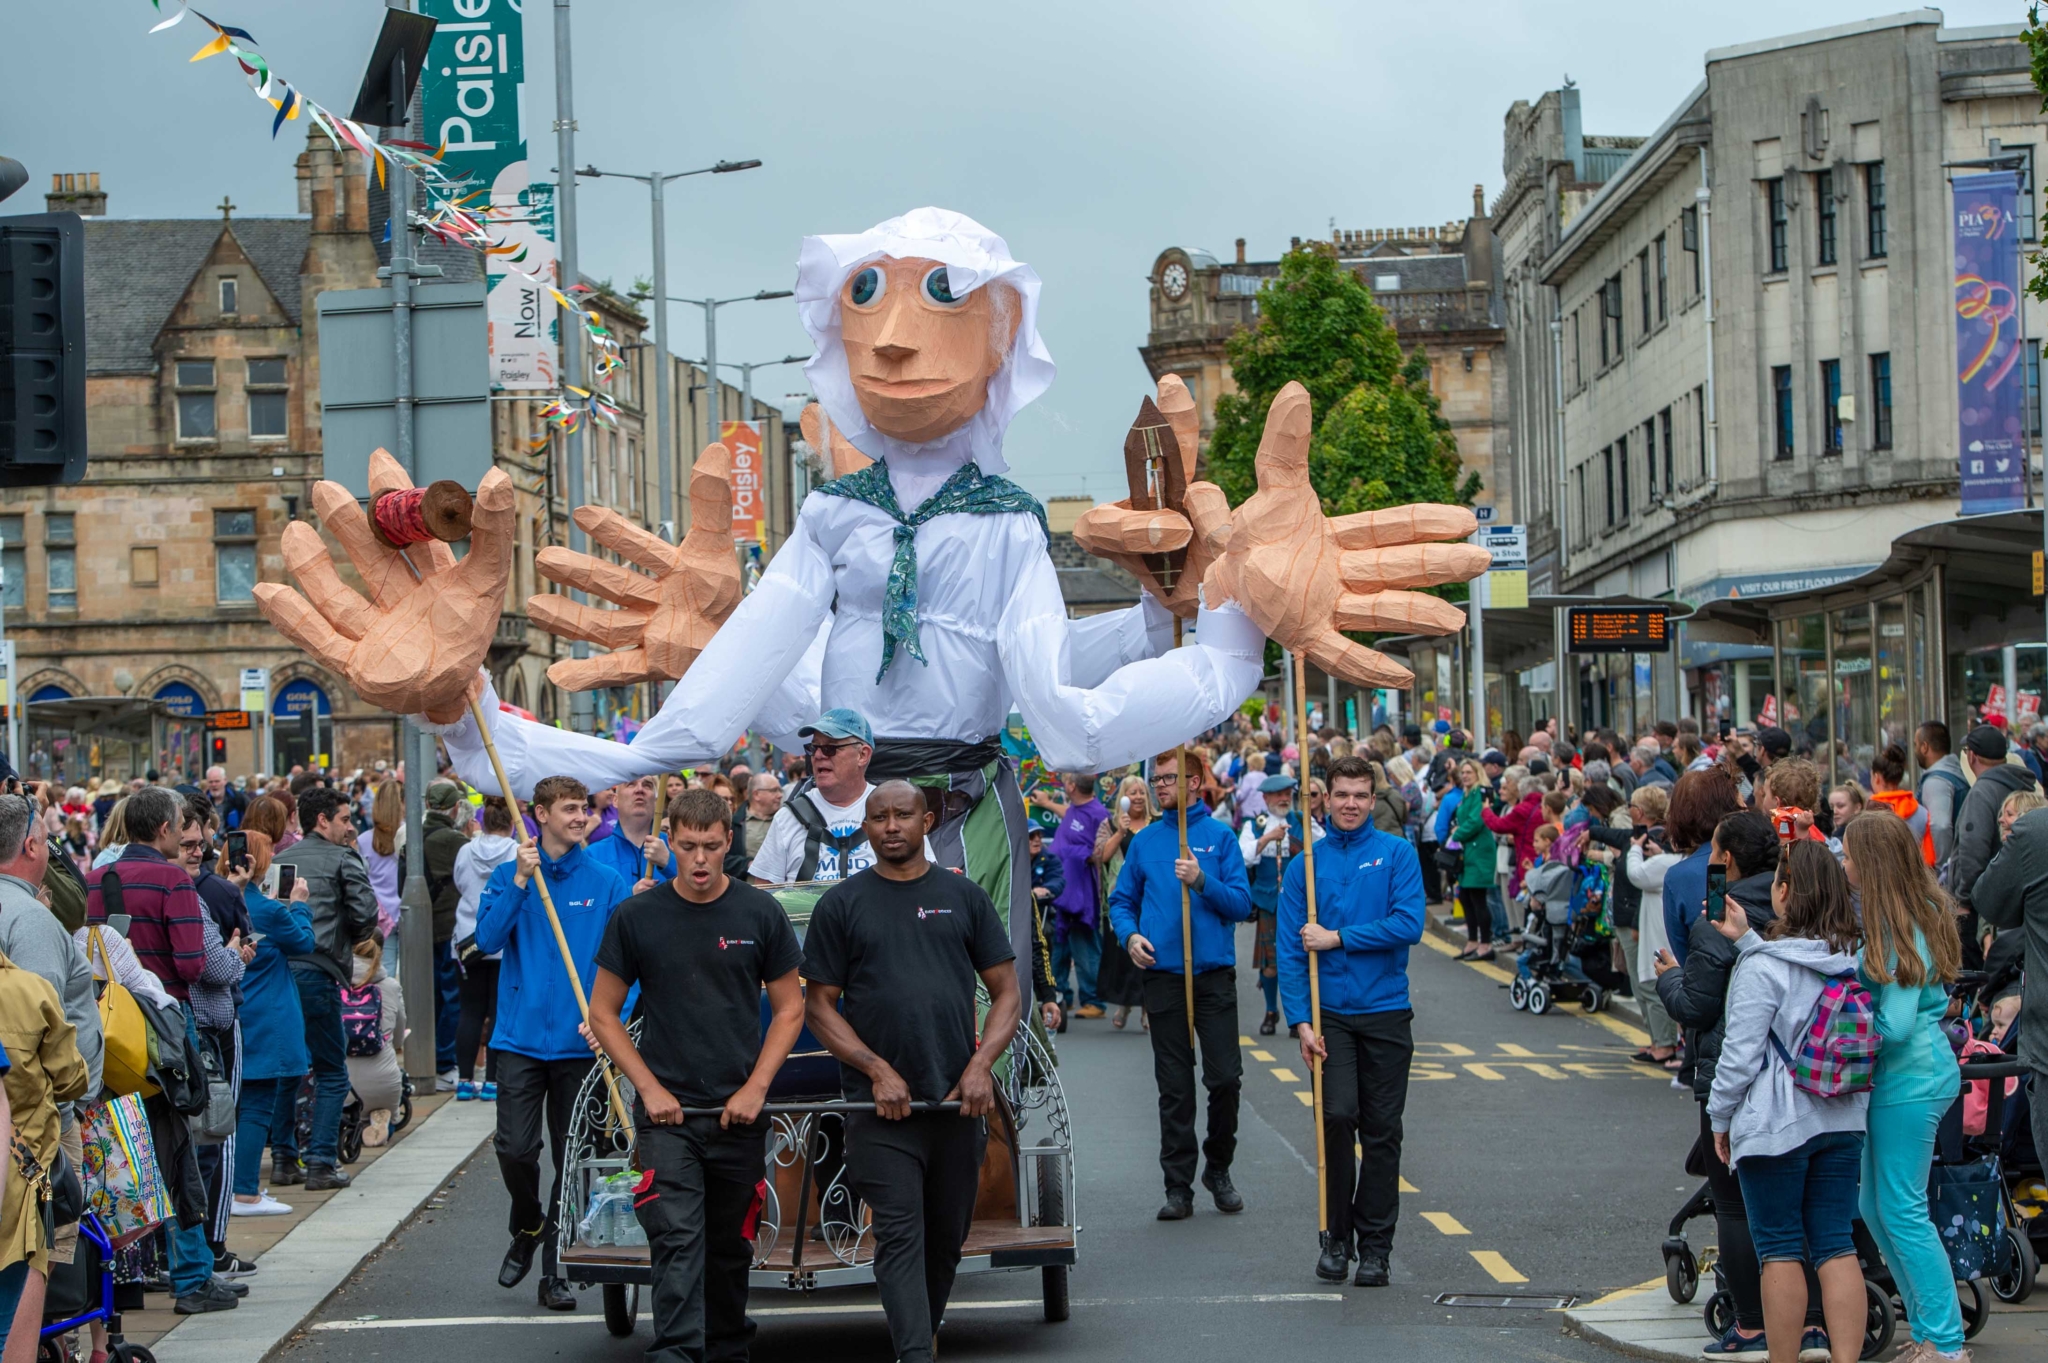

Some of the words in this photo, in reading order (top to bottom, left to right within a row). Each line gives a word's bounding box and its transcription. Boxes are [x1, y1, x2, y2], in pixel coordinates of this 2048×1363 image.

[435, 0, 495, 152] Paisle
[514, 288, 535, 338] Now
[500, 369, 531, 381] Paisley
[731, 442, 757, 520] Paisley
[1479, 509, 1488, 518] H
[1501, 549, 1521, 558] Stop
[1740, 582, 1761, 594] VISIT
[1762, 581, 1780, 592] OUR
[1781, 579, 1803, 591] FIRST
[1805, 577, 1833, 589] FLOOR
[46, 839, 62, 856] Cano
[131, 1120, 147, 1131] 100
